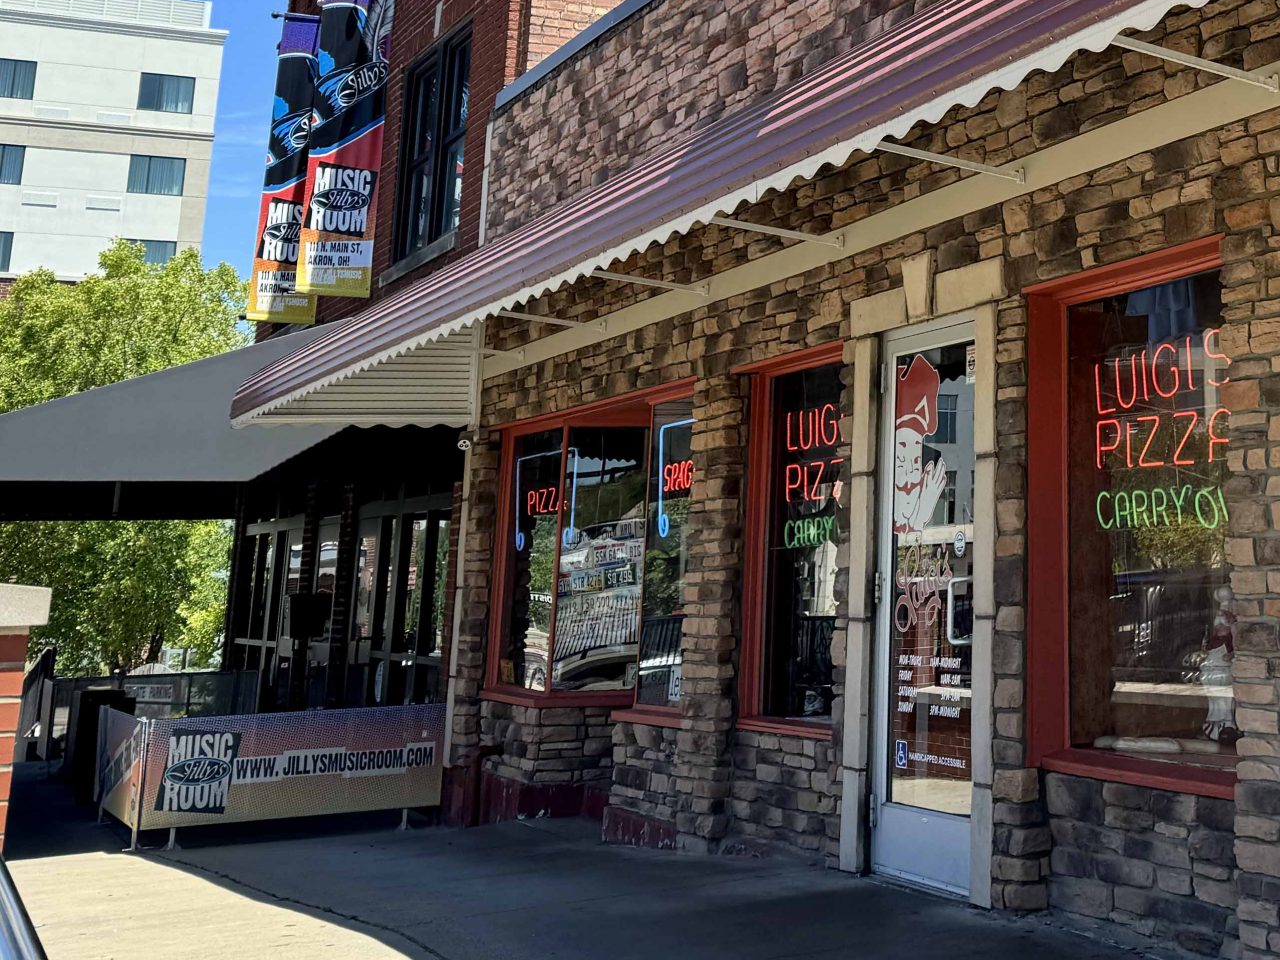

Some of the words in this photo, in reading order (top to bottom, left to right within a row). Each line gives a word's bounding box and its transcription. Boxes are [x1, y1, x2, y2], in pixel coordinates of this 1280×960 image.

[337, 62, 386, 107] Jilly's
[313, 166, 371, 197] MUSIC
[311, 189, 365, 212] Jilly's
[267, 202, 304, 228] MUS
[309, 206, 368, 233] ROOM
[262, 238, 299, 263] ROO
[308, 255, 335, 267] AKRON,
[329, 242, 348, 253] MAIN
[786, 403, 845, 451] LUIG
[663, 459, 696, 492] SPAG
[785, 458, 844, 503] PIZ
[1096, 484, 1192, 530] CARRY
[895, 542, 953, 632] Luigi's
[898, 670, 913, 681] FRIDAY
[897, 701, 915, 713] SUNDAY
[168, 733, 233, 765] MUSIC
[235, 756, 279, 780] WWW.
[282, 745, 434, 776] JILLYSMUSICROOM.COM
[908, 751, 938, 764] HANDICAPPED
[938, 757, 967, 769] ACCESSIBLE
[164, 760, 228, 787] Jilly's
[162, 781, 229, 811] ROOM
